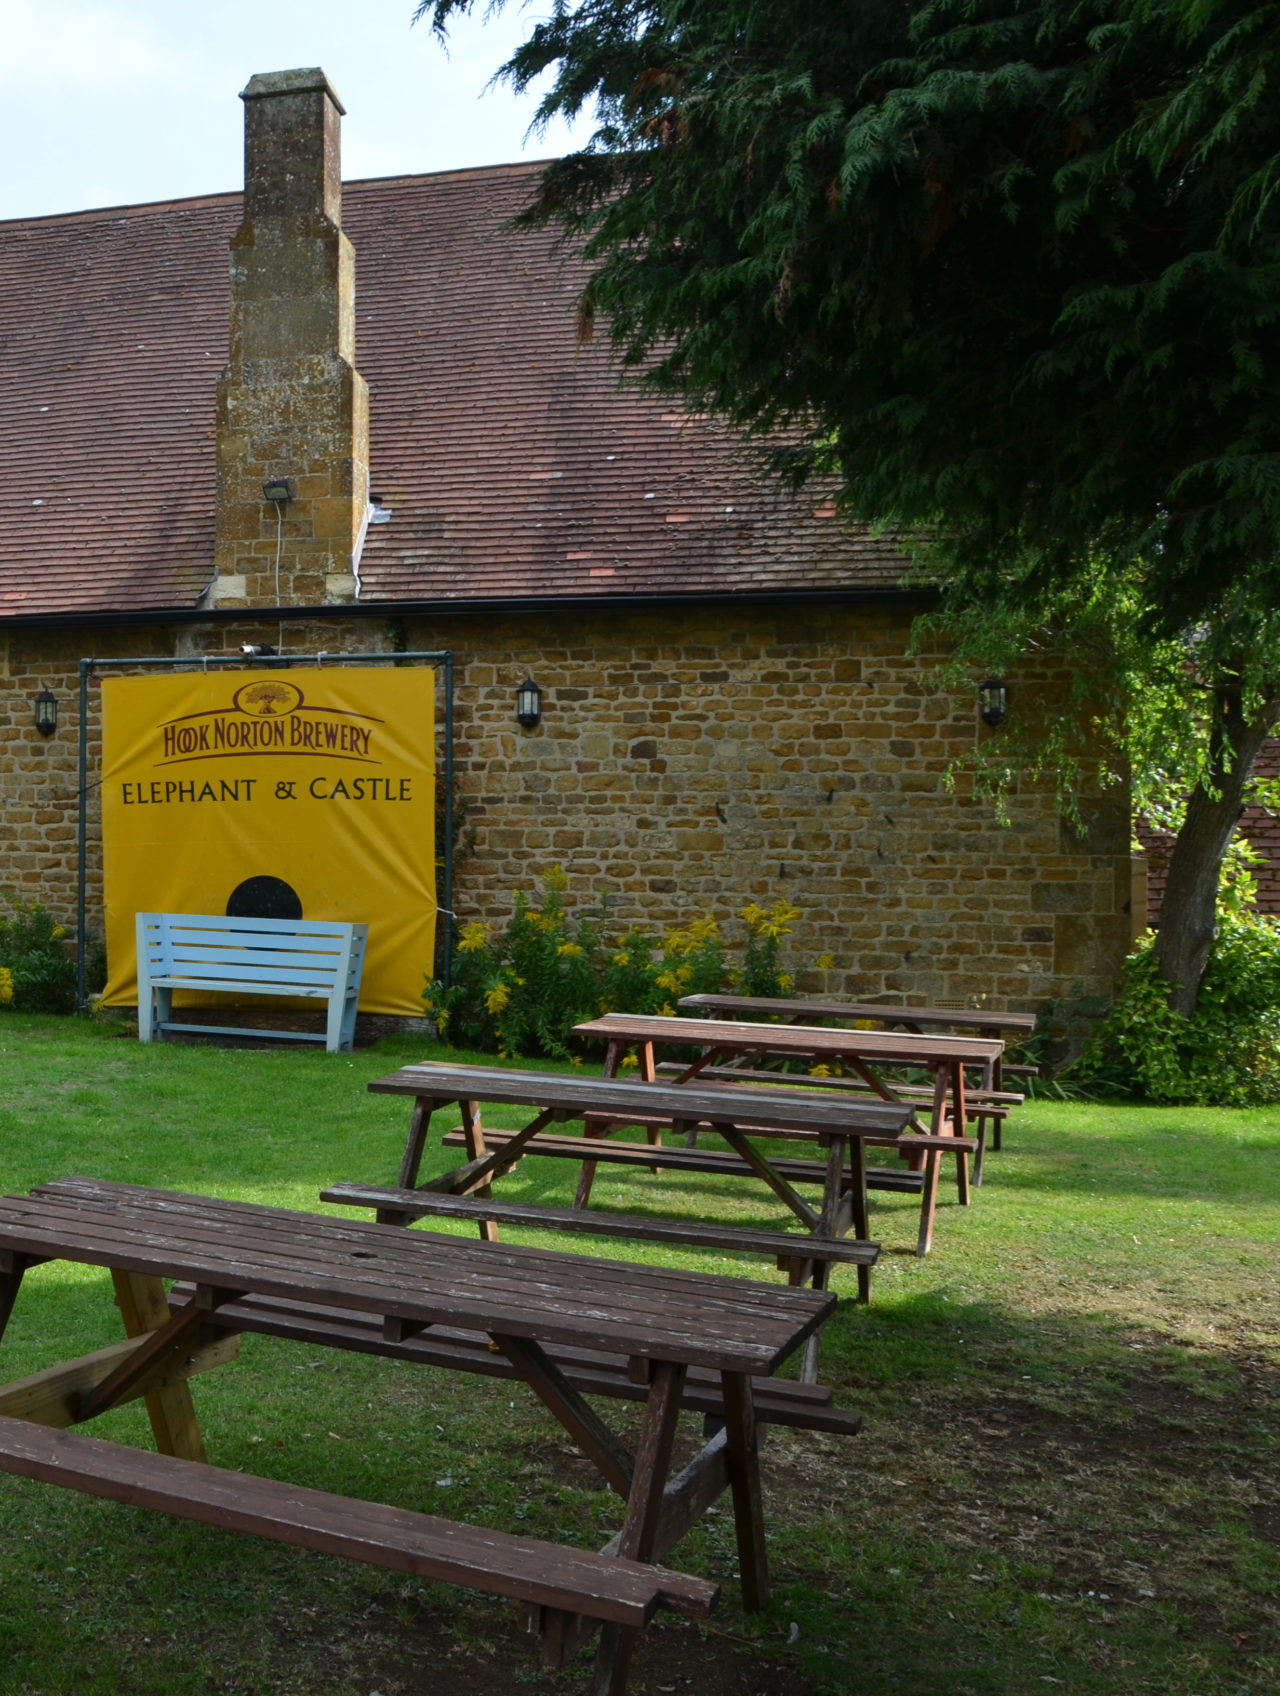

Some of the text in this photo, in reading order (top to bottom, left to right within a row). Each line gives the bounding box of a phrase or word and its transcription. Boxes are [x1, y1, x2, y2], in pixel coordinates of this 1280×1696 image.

[163, 715, 373, 757] HOOK NORTON BREWERY
[122, 777, 412, 804] ELEPHANT & CASTLE
